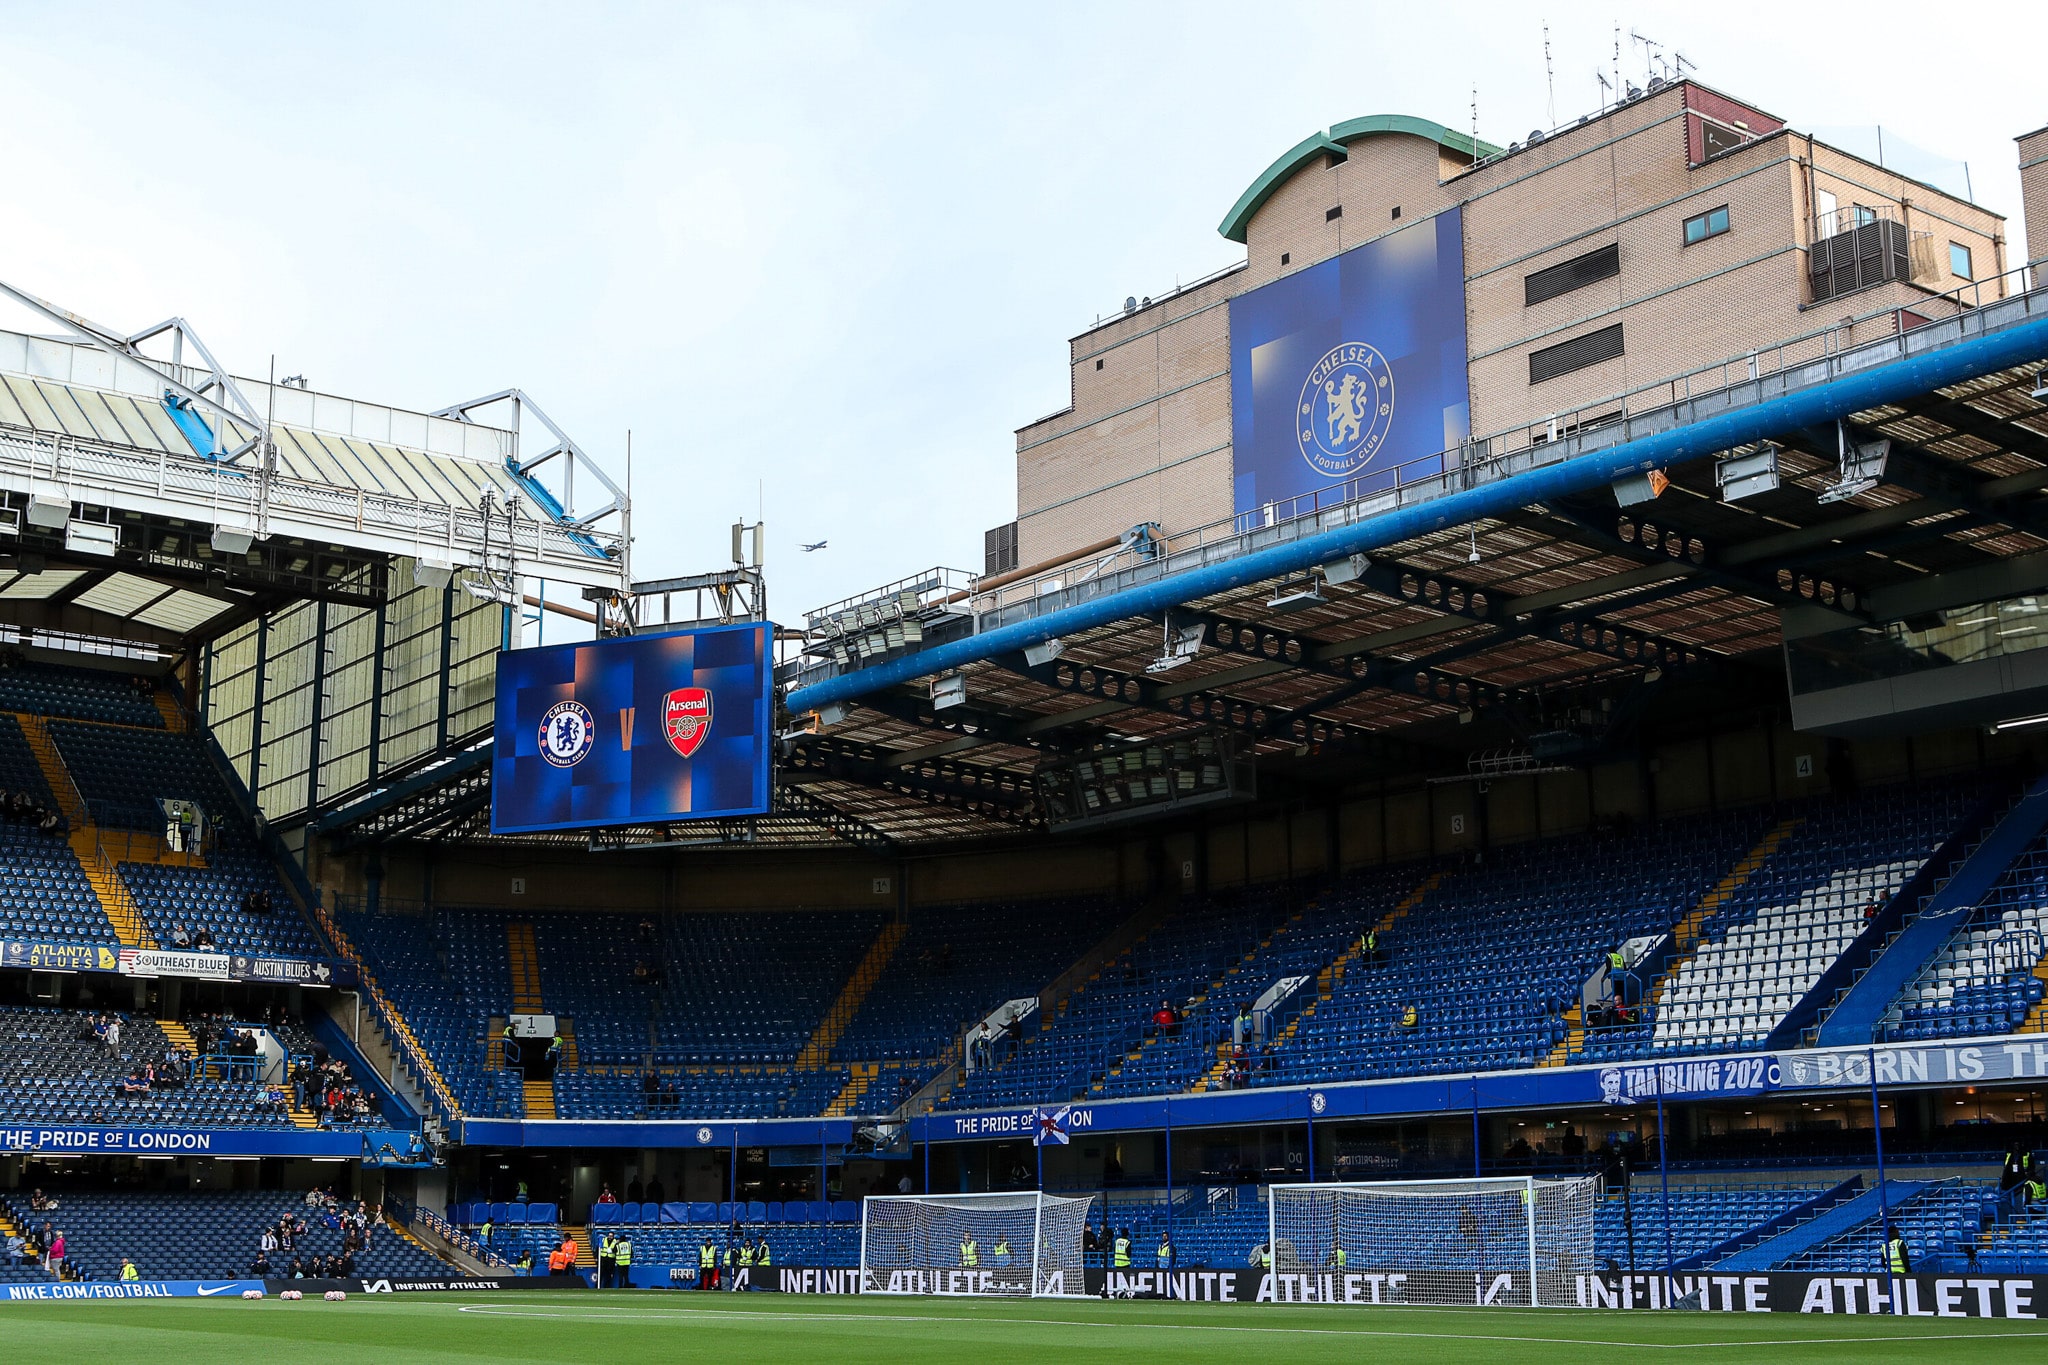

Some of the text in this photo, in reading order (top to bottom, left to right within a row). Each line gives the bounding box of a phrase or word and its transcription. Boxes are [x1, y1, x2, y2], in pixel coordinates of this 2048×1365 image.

[1312, 347, 1374, 385] CHELSEA
[1313, 434, 1378, 470] FOOTBALL CLUB
[549, 703, 585, 719] CHELSEA
[668, 698, 706, 711] Arsenal
[619, 707, 635, 751] V
[547, 750, 585, 764] FOOTBALL CLUB
[1800, 759, 1809, 774] 4
[173, 801, 180, 810] 6
[1455, 818, 1461, 832] 3
[1185, 864, 1191, 876] 2
[515, 881, 521, 893] 1
[31, 944, 93, 957] ATLANTA
[30, 956, 93, 969] BLUES
[136, 955, 228, 970] SOUTHEAST BLUES
[253, 961, 311, 978] AUSTIN BLUES
[528, 1016, 535, 1029] 1
[1817, 1050, 1929, 1084] BORN
[1945, 1047, 1985, 1080] IS
[1724, 1058, 1765, 1090] 202
[955, 1115, 1034, 1134] THE PRIDE OF
[39, 1131, 100, 1147] PRIDE
[104, 1132, 123, 1143] OF
[128, 1133, 210, 1149] LONDON
[8, 1283, 173, 1300] NIKE.COM/FOOTBALL
[394, 1282, 446, 1290] INFINITE
[449, 1281, 500, 1289] ATHLETE
[1106, 1271, 1237, 1302] INFINITE
[1576, 1275, 1772, 1312] INFINITE
[1800, 1277, 2037, 1319] ATHLETE
